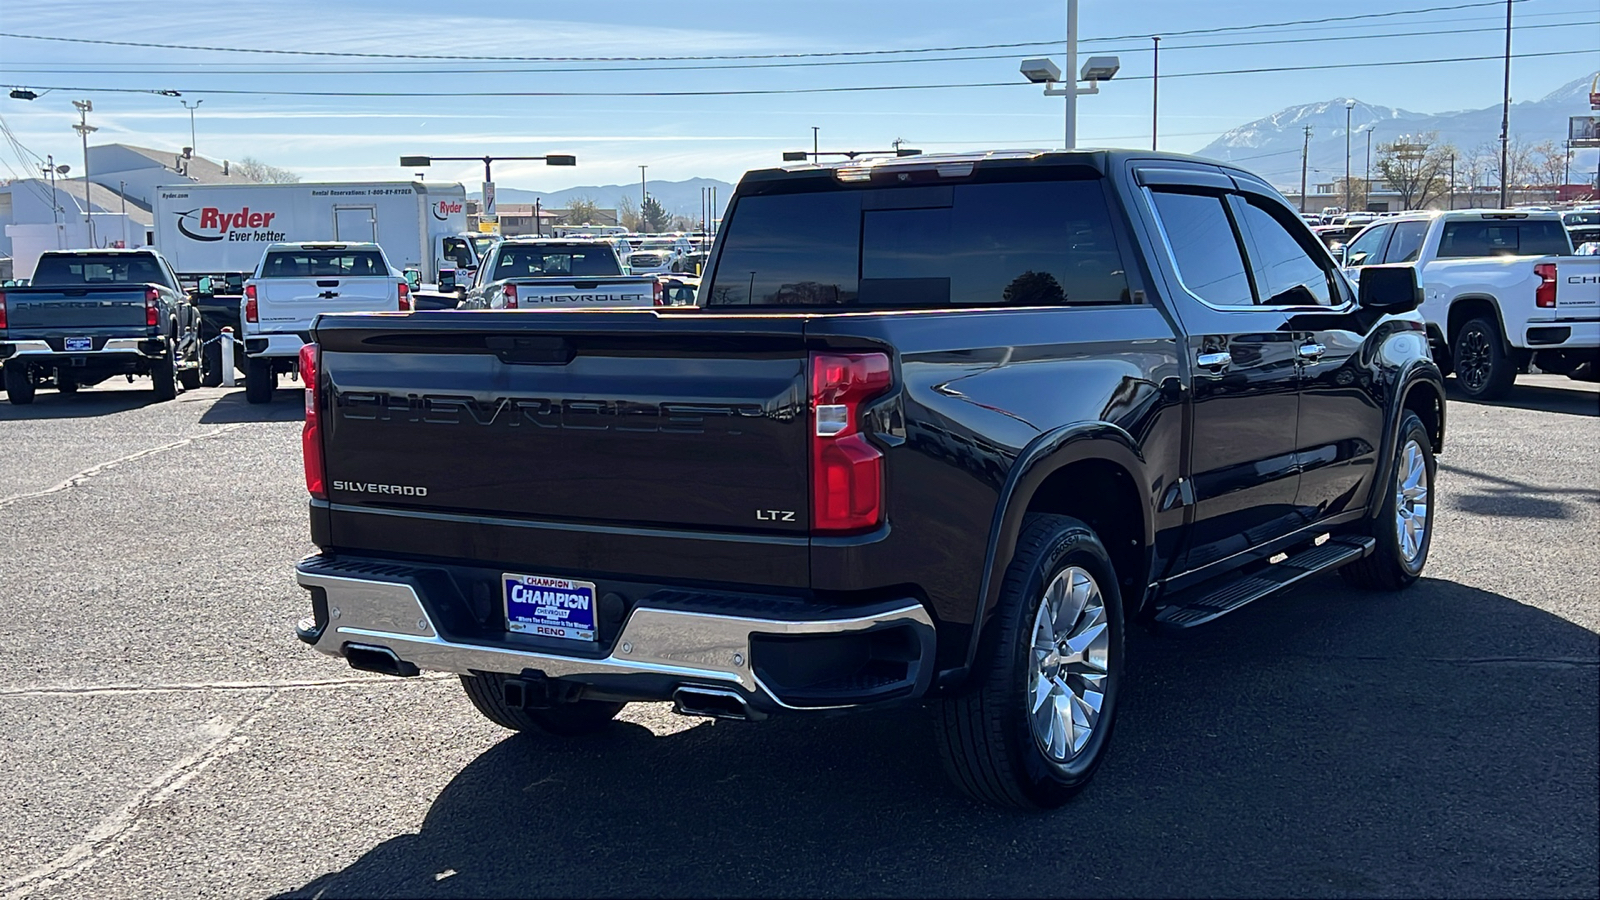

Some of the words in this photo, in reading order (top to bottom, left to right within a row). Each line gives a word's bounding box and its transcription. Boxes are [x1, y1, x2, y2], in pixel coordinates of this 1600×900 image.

[440, 201, 463, 216] Ryder
[200, 207, 275, 234] Ryder
[228, 231, 251, 241] Ever
[253, 230, 286, 241] better.
[527, 294, 645, 303] CHEVROLET
[333, 480, 428, 497] SILVERADO
[756, 509, 796, 522] LTZ
[526, 577, 569, 588] CHAMPION
[537, 608, 568, 617] CHEVROLET
[537, 627, 565, 636] RENO
